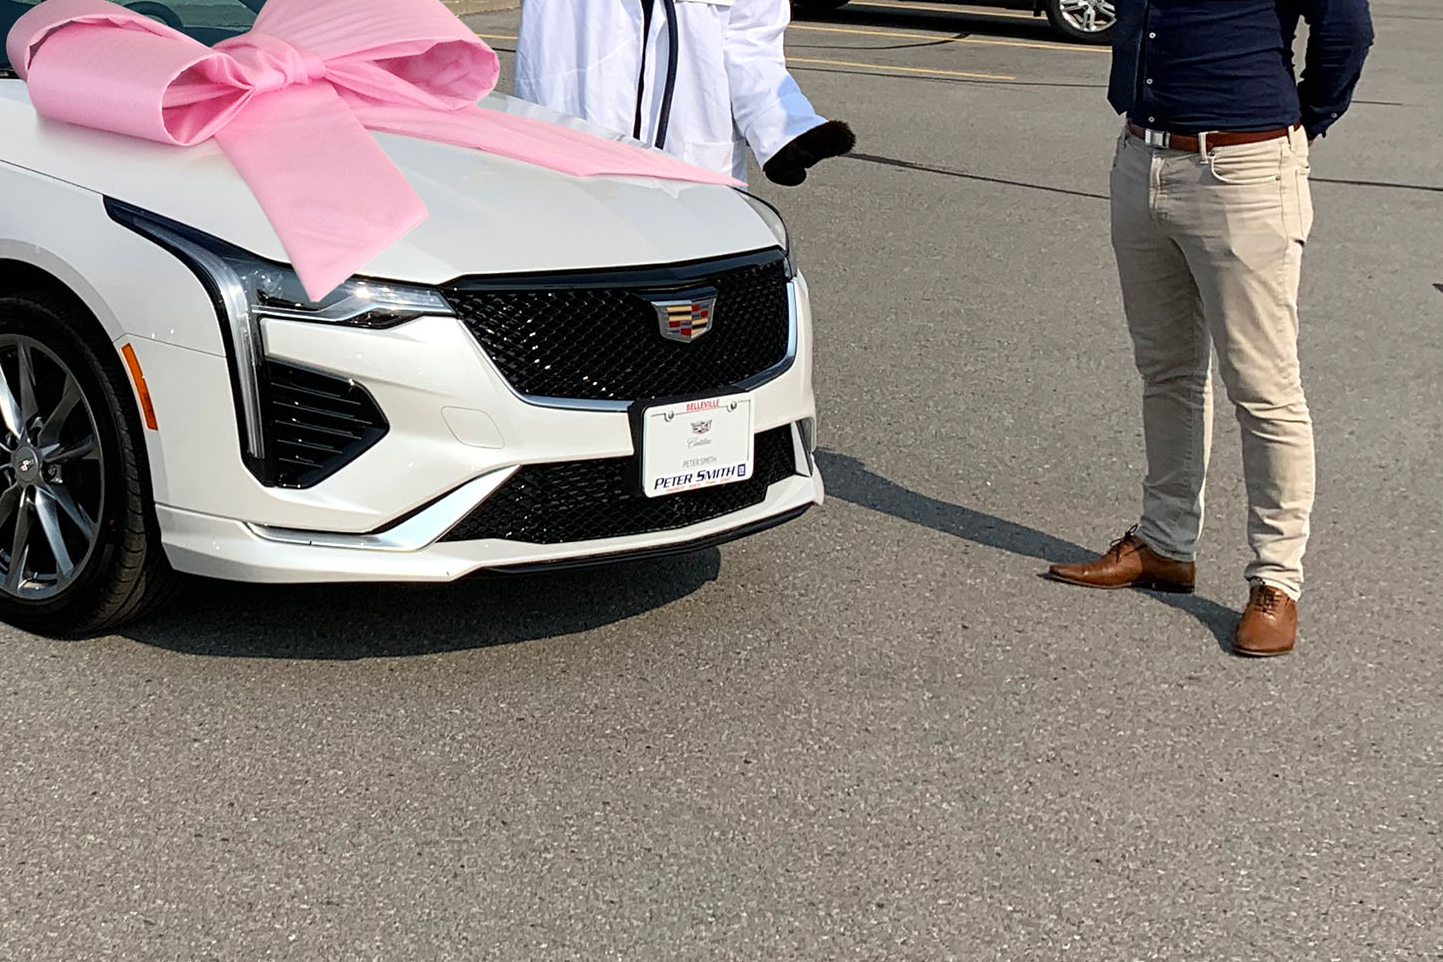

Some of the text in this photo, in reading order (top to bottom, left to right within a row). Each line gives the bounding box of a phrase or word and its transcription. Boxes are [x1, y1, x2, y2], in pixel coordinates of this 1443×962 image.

[686, 399, 720, 411] BELLEVILLE
[682, 455, 717, 469] PETER SMITH
[654, 473, 693, 490] PETER
[696, 466, 736, 483] SMITH
